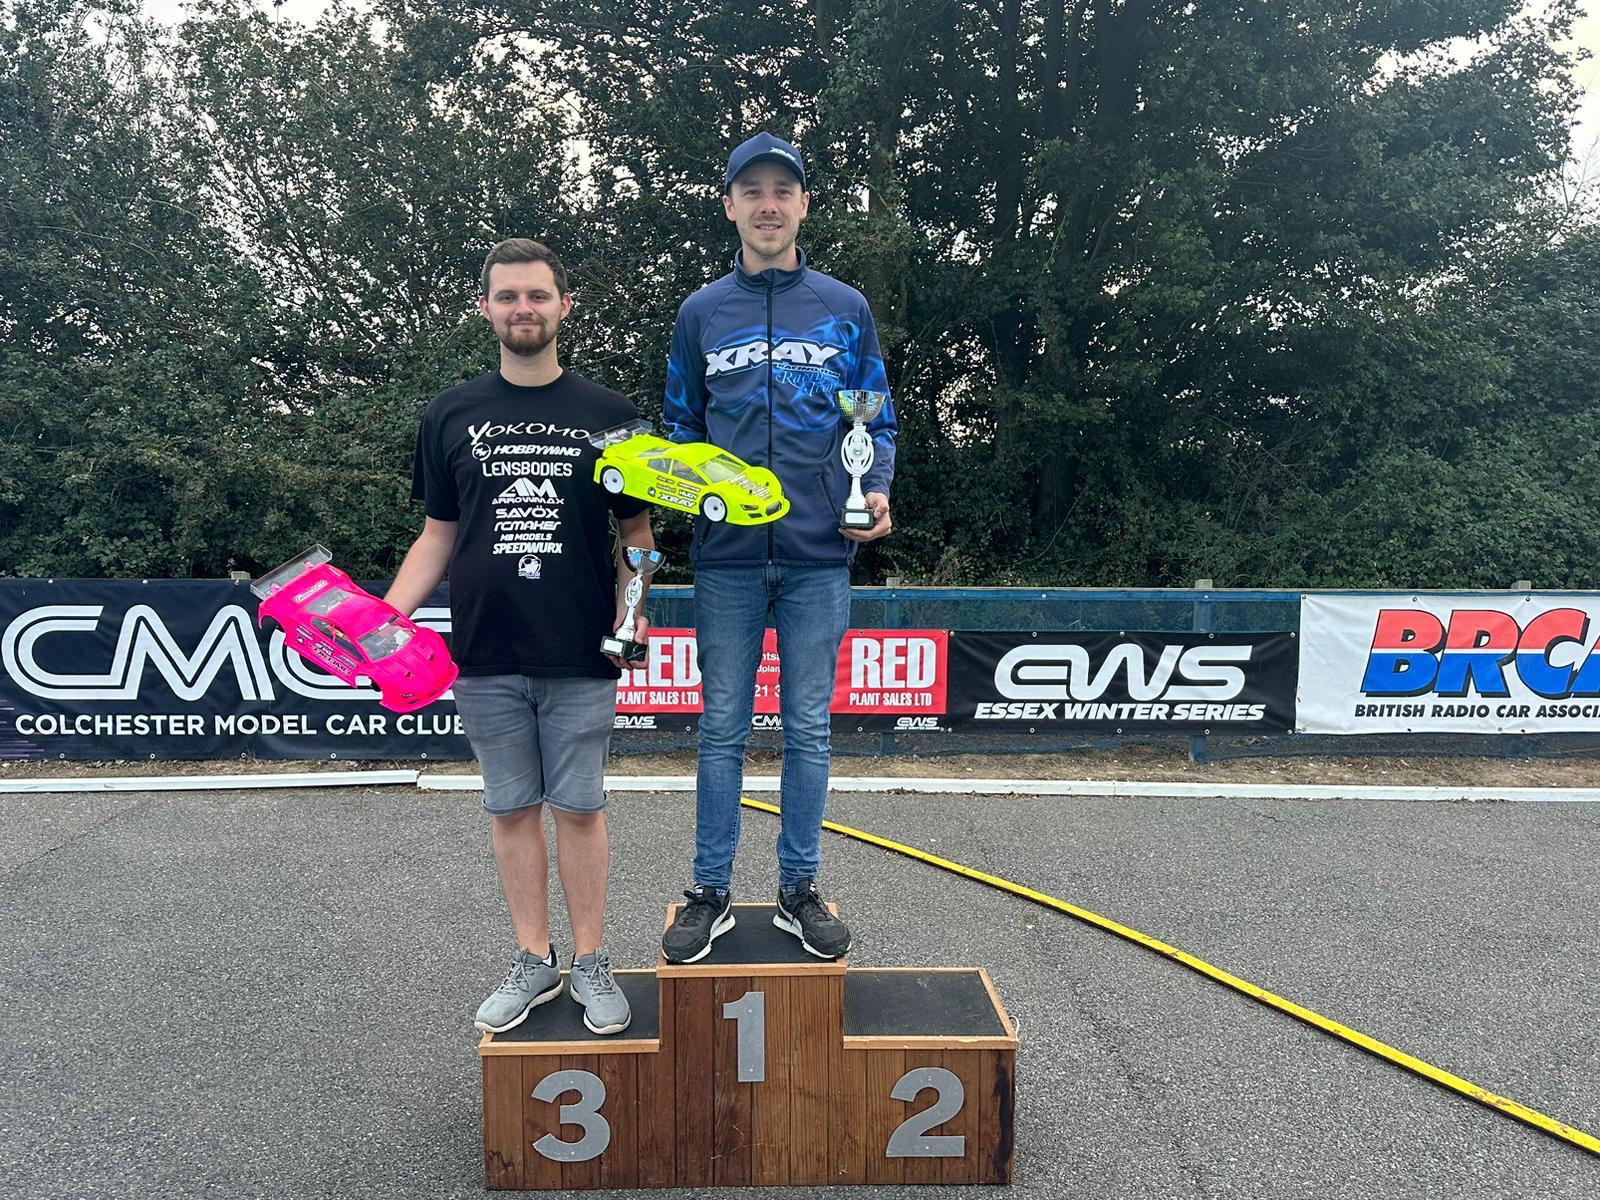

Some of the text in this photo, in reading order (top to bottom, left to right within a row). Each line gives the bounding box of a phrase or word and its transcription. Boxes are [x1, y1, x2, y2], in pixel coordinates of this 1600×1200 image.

[705, 341, 840, 376] XRAY
[468, 421, 590, 446] YOKOMO
[492, 444, 582, 457] HOBBYWING
[482, 461, 573, 477] LENSBODIES
[492, 496, 564, 505] ARROWMAX
[496, 505, 559, 518] SAVÖX
[514, 533, 553, 541] MODELS
[492, 542, 563, 554] SPEEDWURX
[851, 637, 937, 689] RED
[615, 691, 699, 705] PLANT SALES LTD
[849, 692, 932, 706] PLANT SALES LTD
[974, 703, 1266, 721] ESSEX WINTER SERIES
[1354, 704, 1600, 718] BRITISH RADIO CAR ASSOCI
[15, 714, 205, 735] COLCHESTER
[214, 714, 317, 735] MODEL
[325, 714, 387, 735] CAR
[752, 715, 781, 726] CM
[723, 992, 765, 1082] 1
[531, 1069, 610, 1162] 3
[886, 1067, 966, 1158] 2
